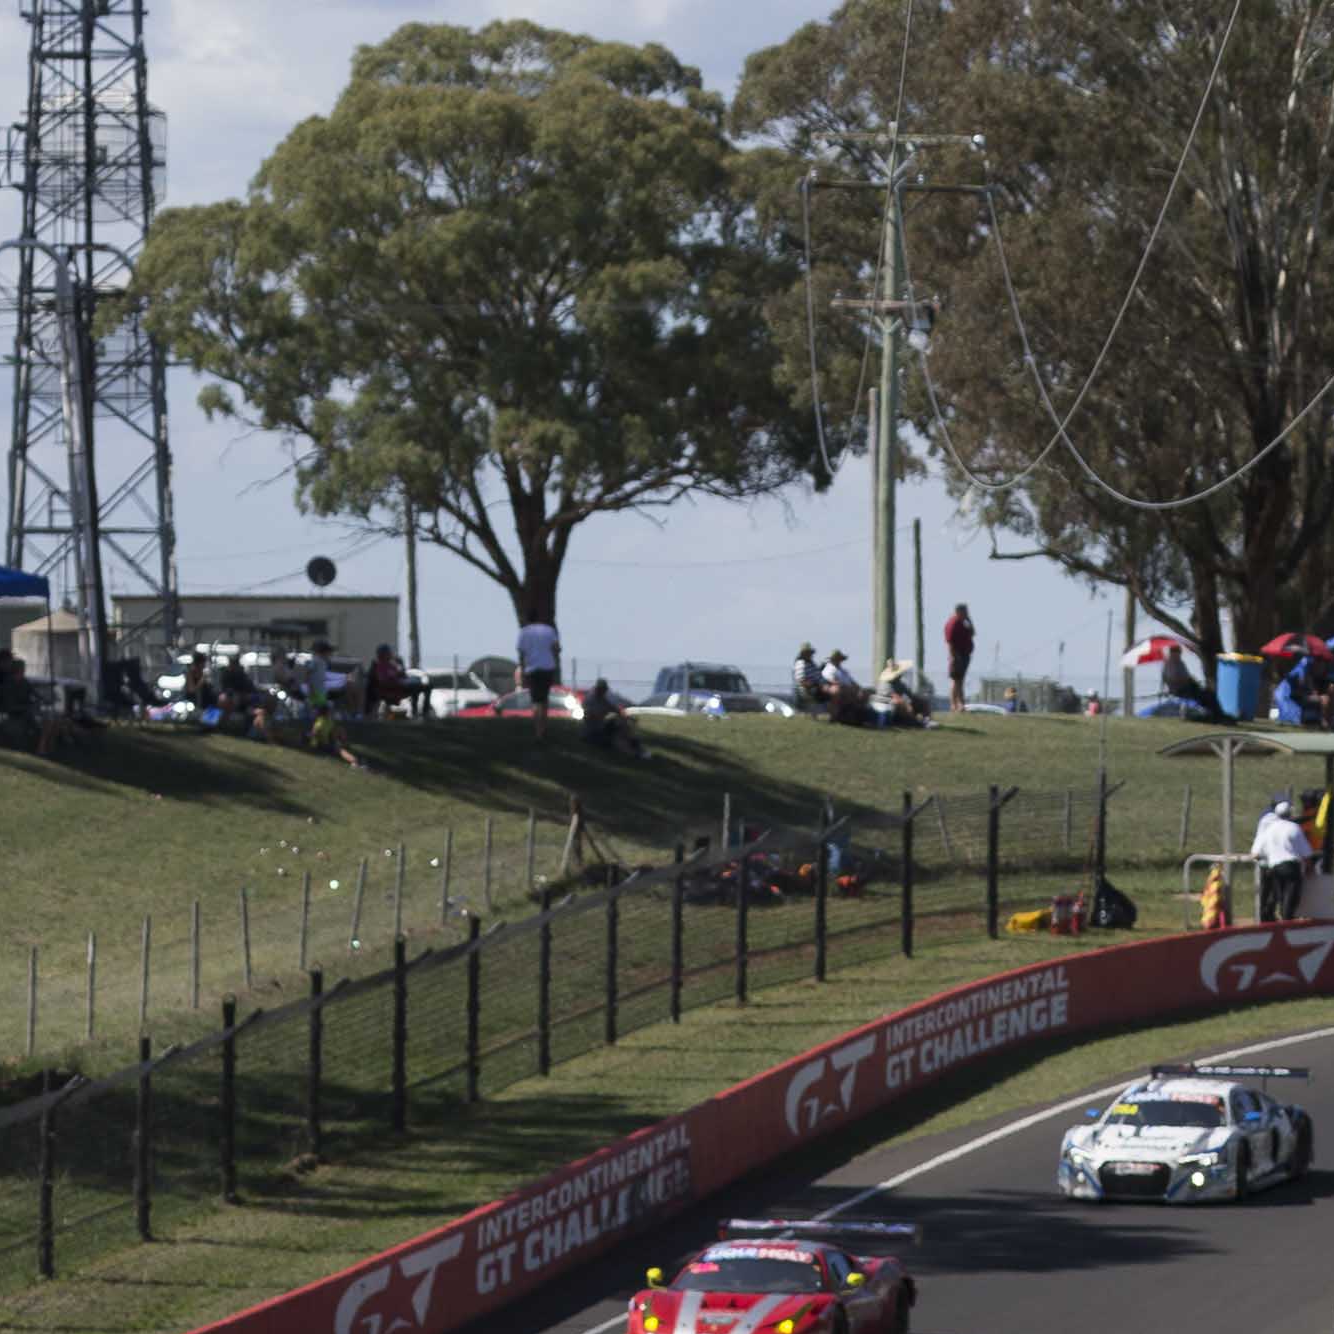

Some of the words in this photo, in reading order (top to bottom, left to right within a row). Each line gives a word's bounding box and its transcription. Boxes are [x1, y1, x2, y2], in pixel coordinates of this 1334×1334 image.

[886, 965, 1069, 1050] INTERCONTINENTAL
[886, 1049, 916, 1089] GT
[919, 991, 1069, 1074] CHALLENGE
[477, 1123, 691, 1250] INTERCONTINENTAL
[475, 1242, 516, 1295] GT
